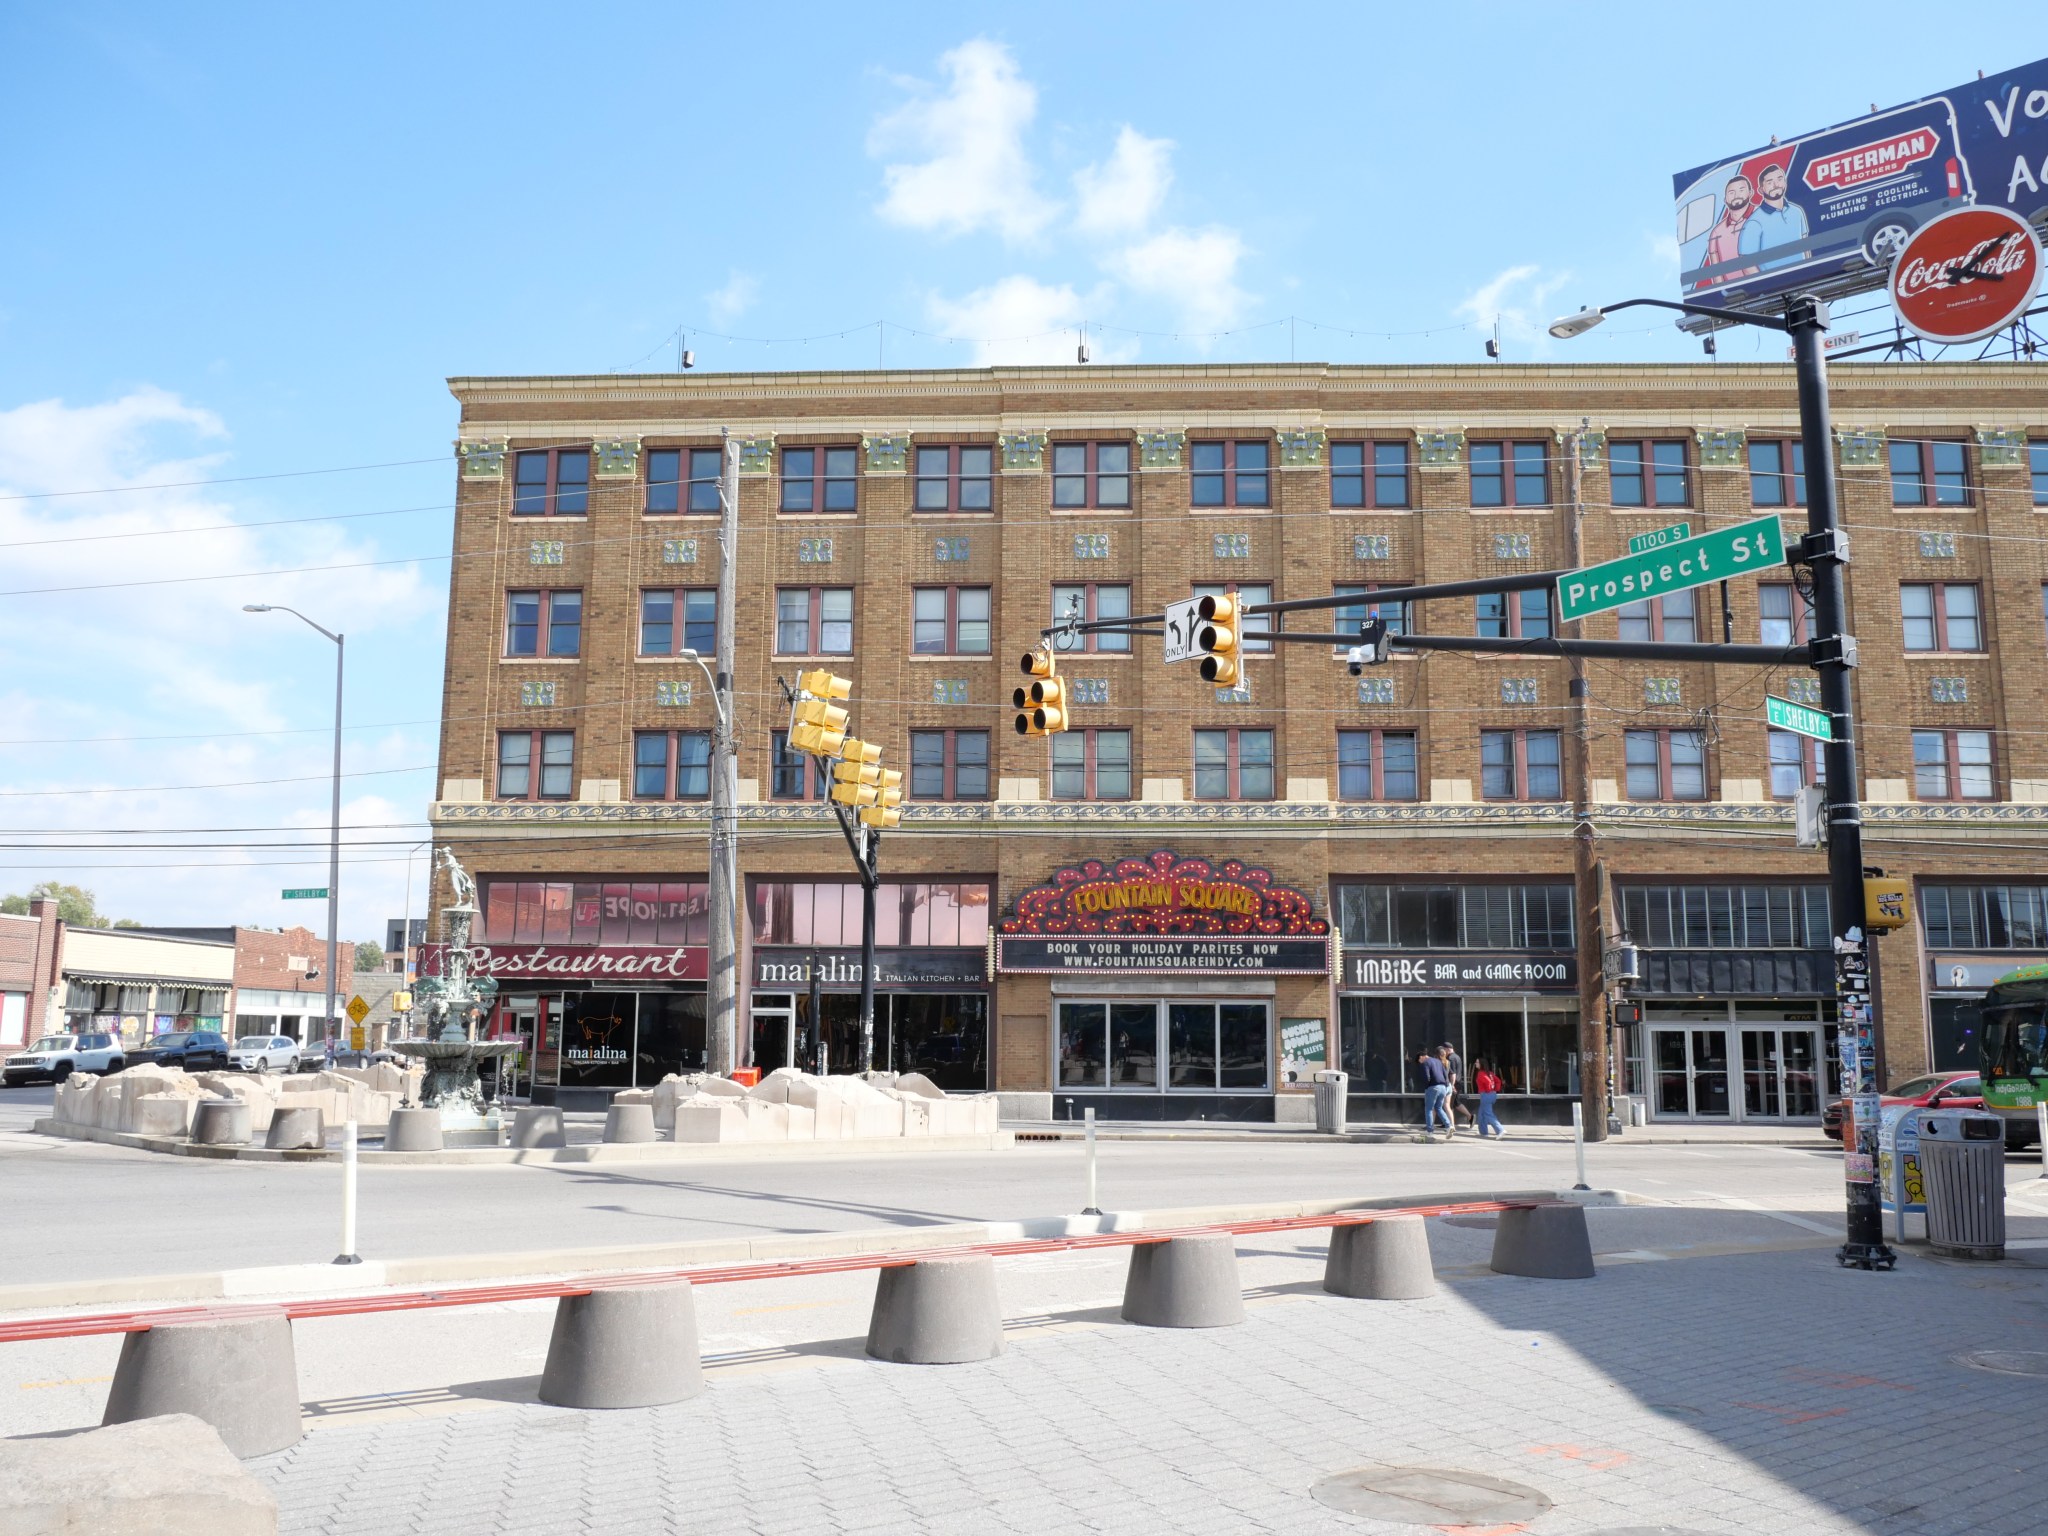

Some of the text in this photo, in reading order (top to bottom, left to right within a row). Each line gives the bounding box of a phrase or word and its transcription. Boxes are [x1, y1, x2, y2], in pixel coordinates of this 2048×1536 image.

[1816, 136, 1925, 181] PETERMAN
[1845, 163, 1897, 182] BROTHERS
[2008, 155, 2048, 203] A
[1821, 187, 1929, 221] PLUMBING ELECTRICAL
[1830, 182, 1918, 211] HEATING COOLING
[1636, 527, 1682, 551] 1100 S
[1568, 532, 1769, 608] Prospect St
[1361, 620, 1374, 630] 327
[1165, 645, 1186, 658] ONLY
[1774, 706, 1829, 734] E SHELBY ST
[294, 889, 320, 898] SHELBY
[1074, 883, 1255, 915] FOUNTAIN SQUARE
[1047, 943, 1078, 954] BOOK
[1089, 943, 1121, 954] YOUR
[1132, 943, 1183, 954] HOLIDAY
[1253, 944, 1278, 955] NOW
[468, 946, 690, 976] Restaurant
[1064, 956, 1263, 968] WWW.FOUNTAINSQUAREINDY.COM
[1434, 964, 1458, 979] BAR
[1462, 965, 1481, 979] and
[1485, 964, 1521, 979] GAME
[1524, 964, 1566, 980] ROOM
[568, 1045, 627, 1059] maialina
[1303, 1044, 1324, 1055] ALLEYS
[2015, 1096, 2032, 1107] 1988
